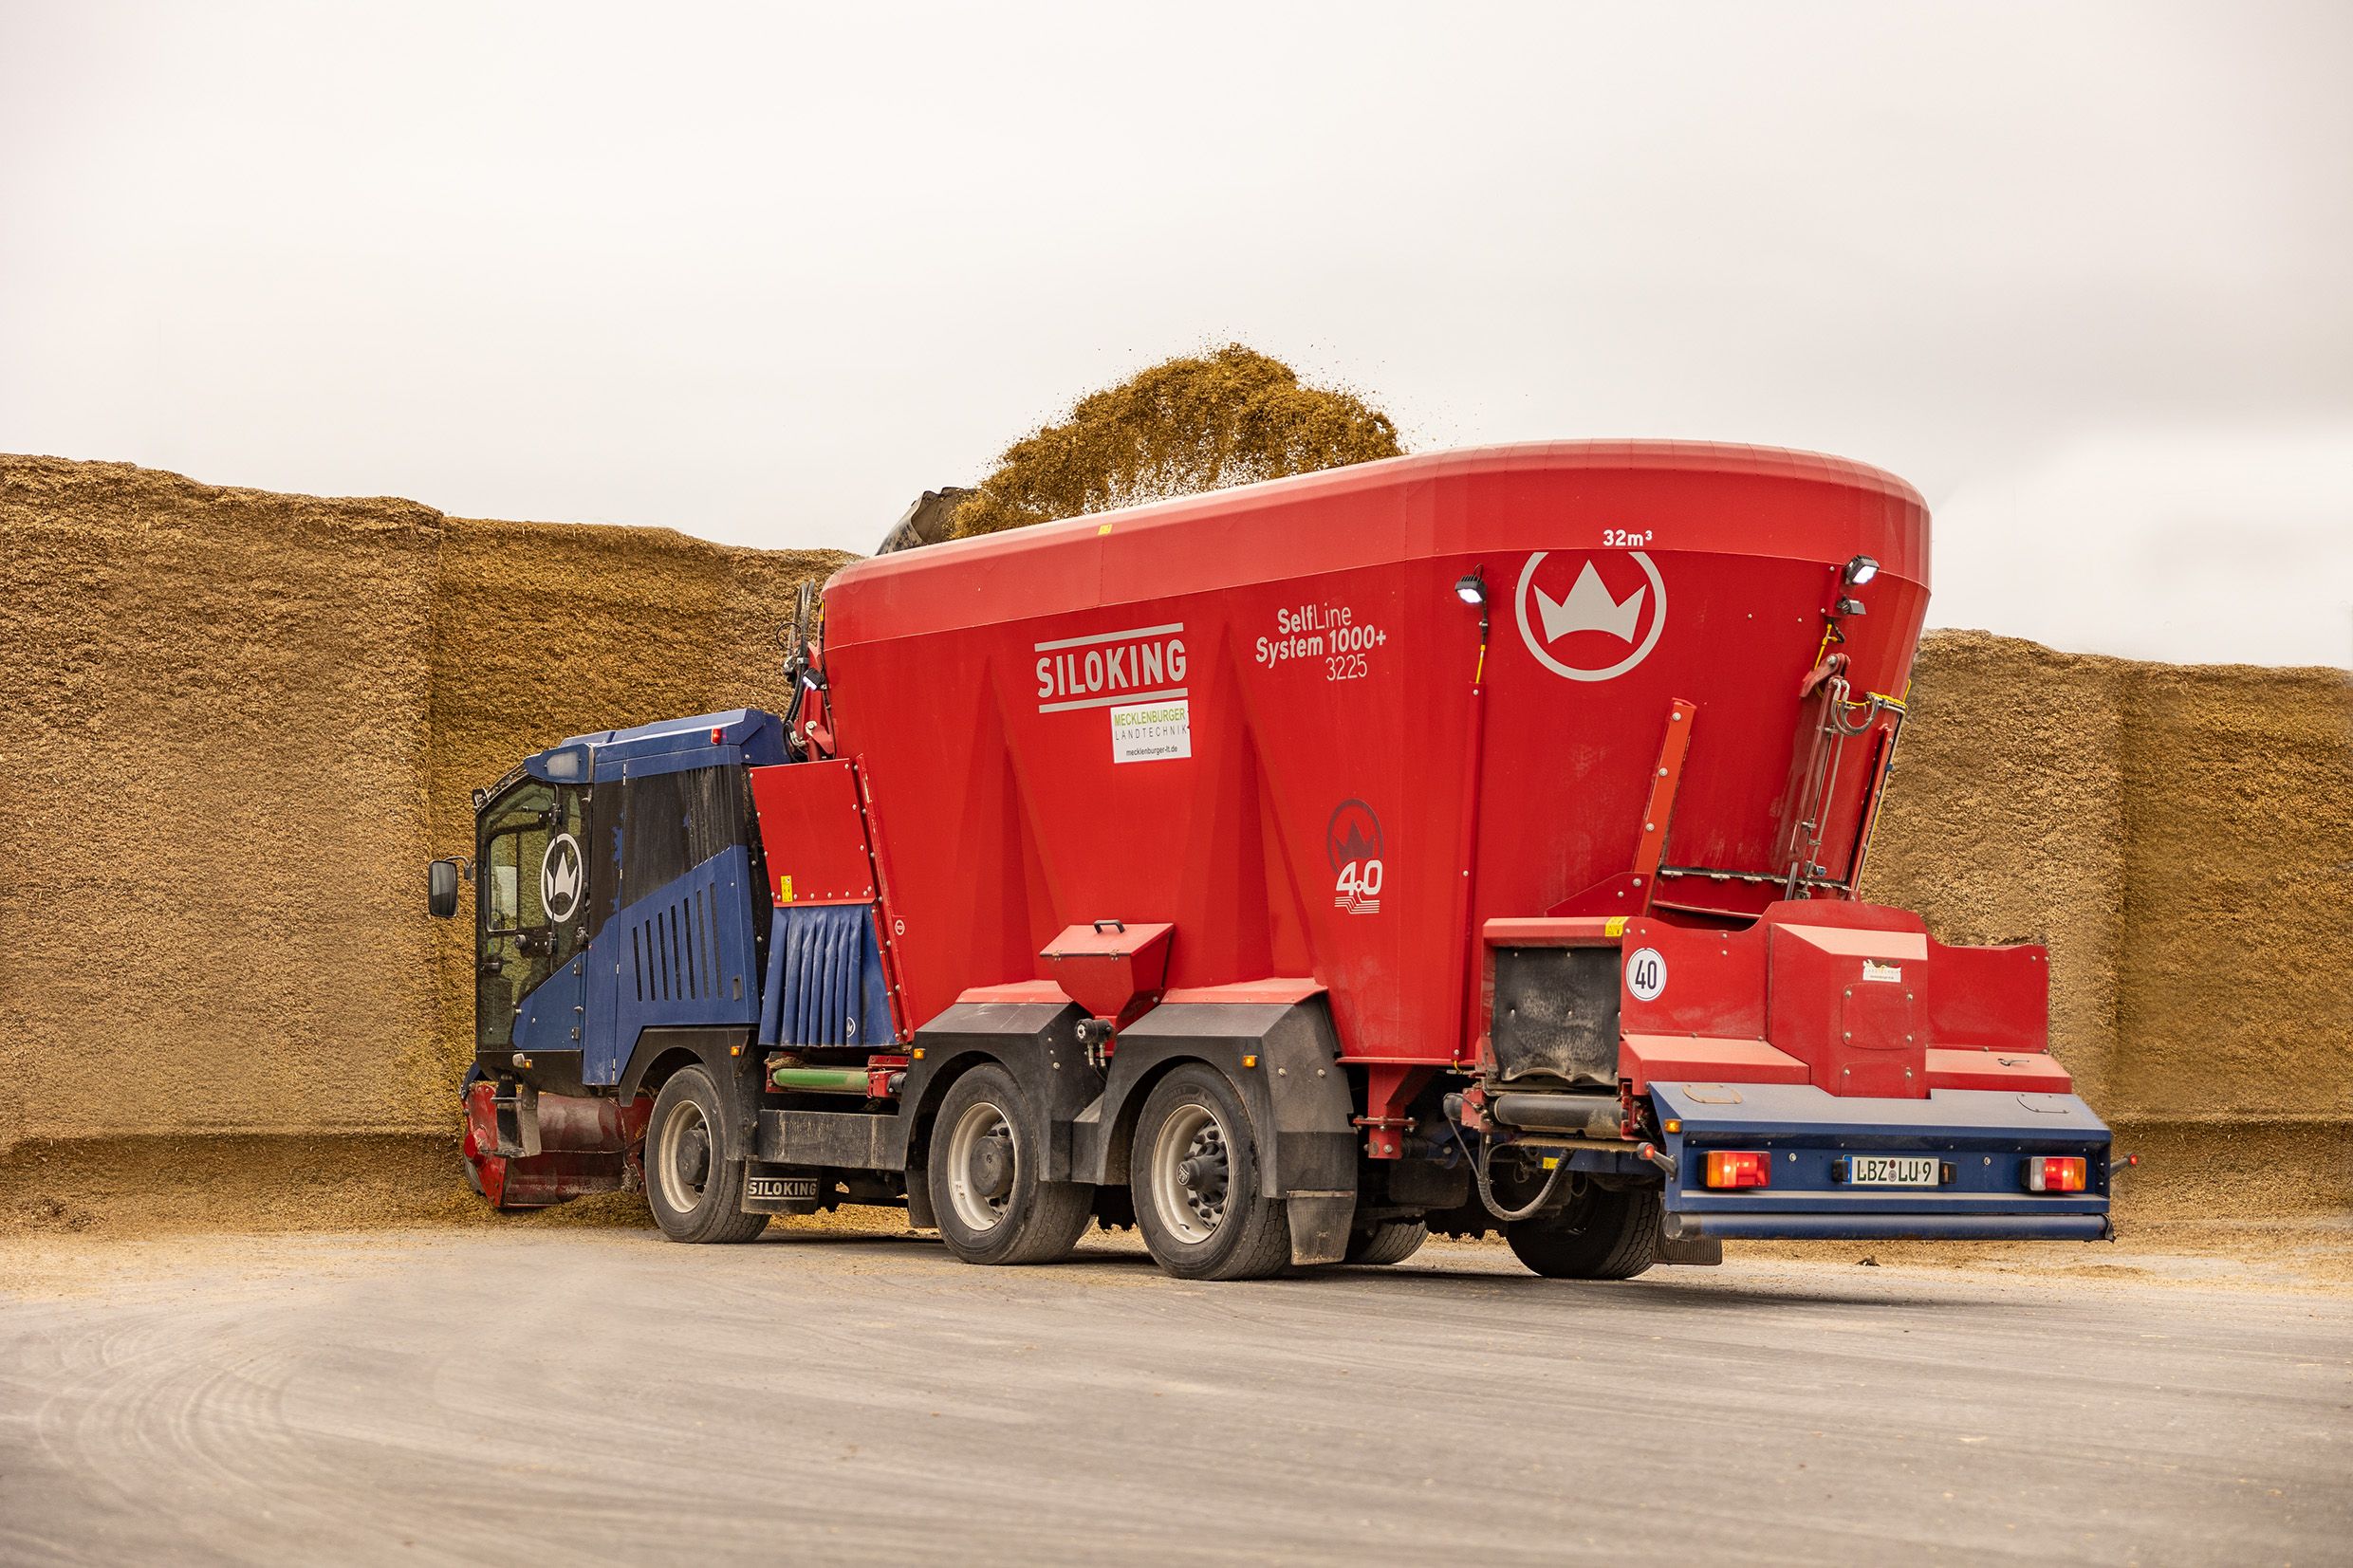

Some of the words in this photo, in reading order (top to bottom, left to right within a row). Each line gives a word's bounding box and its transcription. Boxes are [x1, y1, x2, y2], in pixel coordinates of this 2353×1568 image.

[1603, 528, 1653, 546] 32m³
[1277, 602, 1351, 635] SelfLine
[1255, 636, 1324, 669] System
[1329, 624, 1386, 654] 1000+
[1036, 639, 1186, 698] SILOKING
[1325, 654, 1367, 681] 3225
[1114, 708, 1186, 727] MECKLENBURGER
[1115, 724, 1187, 741] LANDTECHNIK
[1125, 745, 1178, 756] mecklenburger-lt.de
[1635, 959, 1657, 989] 40
[748, 1181, 817, 1196] SILOKING
